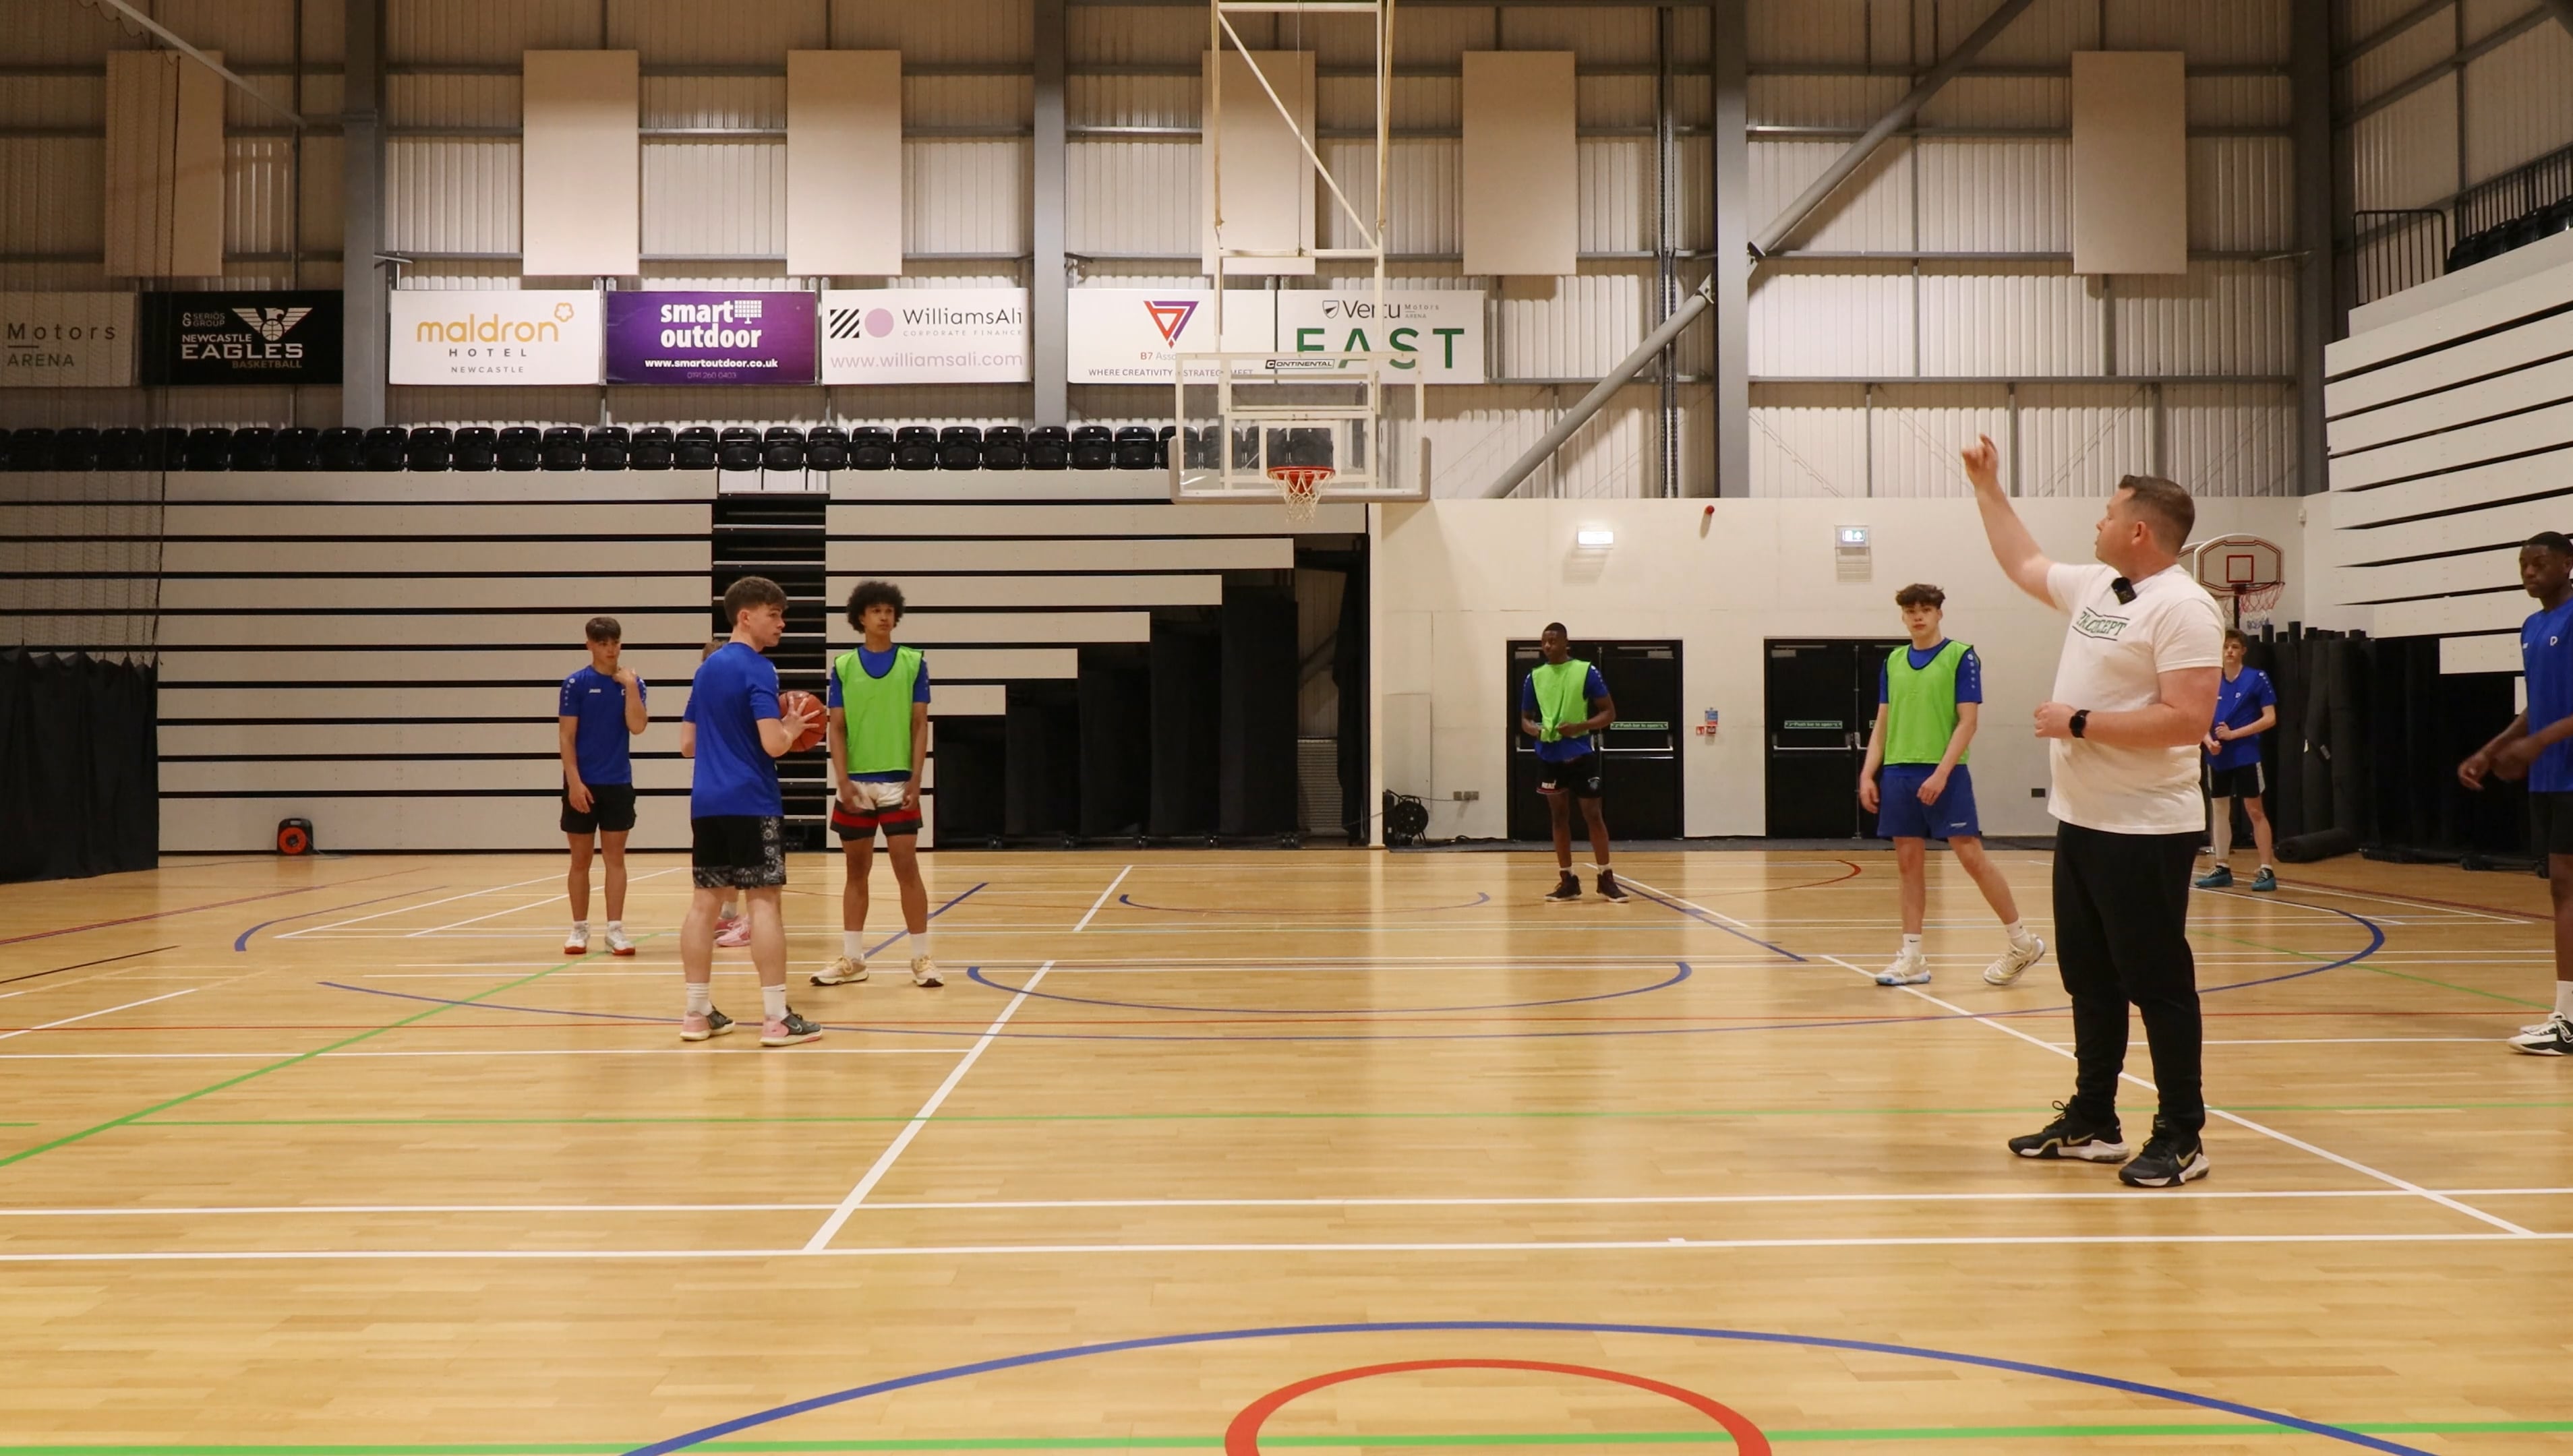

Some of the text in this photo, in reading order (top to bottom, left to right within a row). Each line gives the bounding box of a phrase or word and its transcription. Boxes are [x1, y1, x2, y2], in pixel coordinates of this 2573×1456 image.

[661, 301, 734, 323] smart
[903, 308, 1023, 325] WilliamsAli
[1342, 300, 1400, 319] Veru
[7, 323, 115, 340] Motors
[417, 313, 559, 342] maldron
[182, 334, 252, 342] NEWCASTLE
[661, 323, 762, 348] outdoor
[181, 344, 303, 359] EAGLES
[449, 348, 527, 357] HOTEL
[1140, 352, 1153, 360] B7
[7, 354, 74, 367] ARENA
[645, 359, 778, 367] www.smartoutdoor.co.uk
[831, 352, 1023, 368] www.williamsali.com
[1266, 360, 1333, 368] CONTINENTAL
